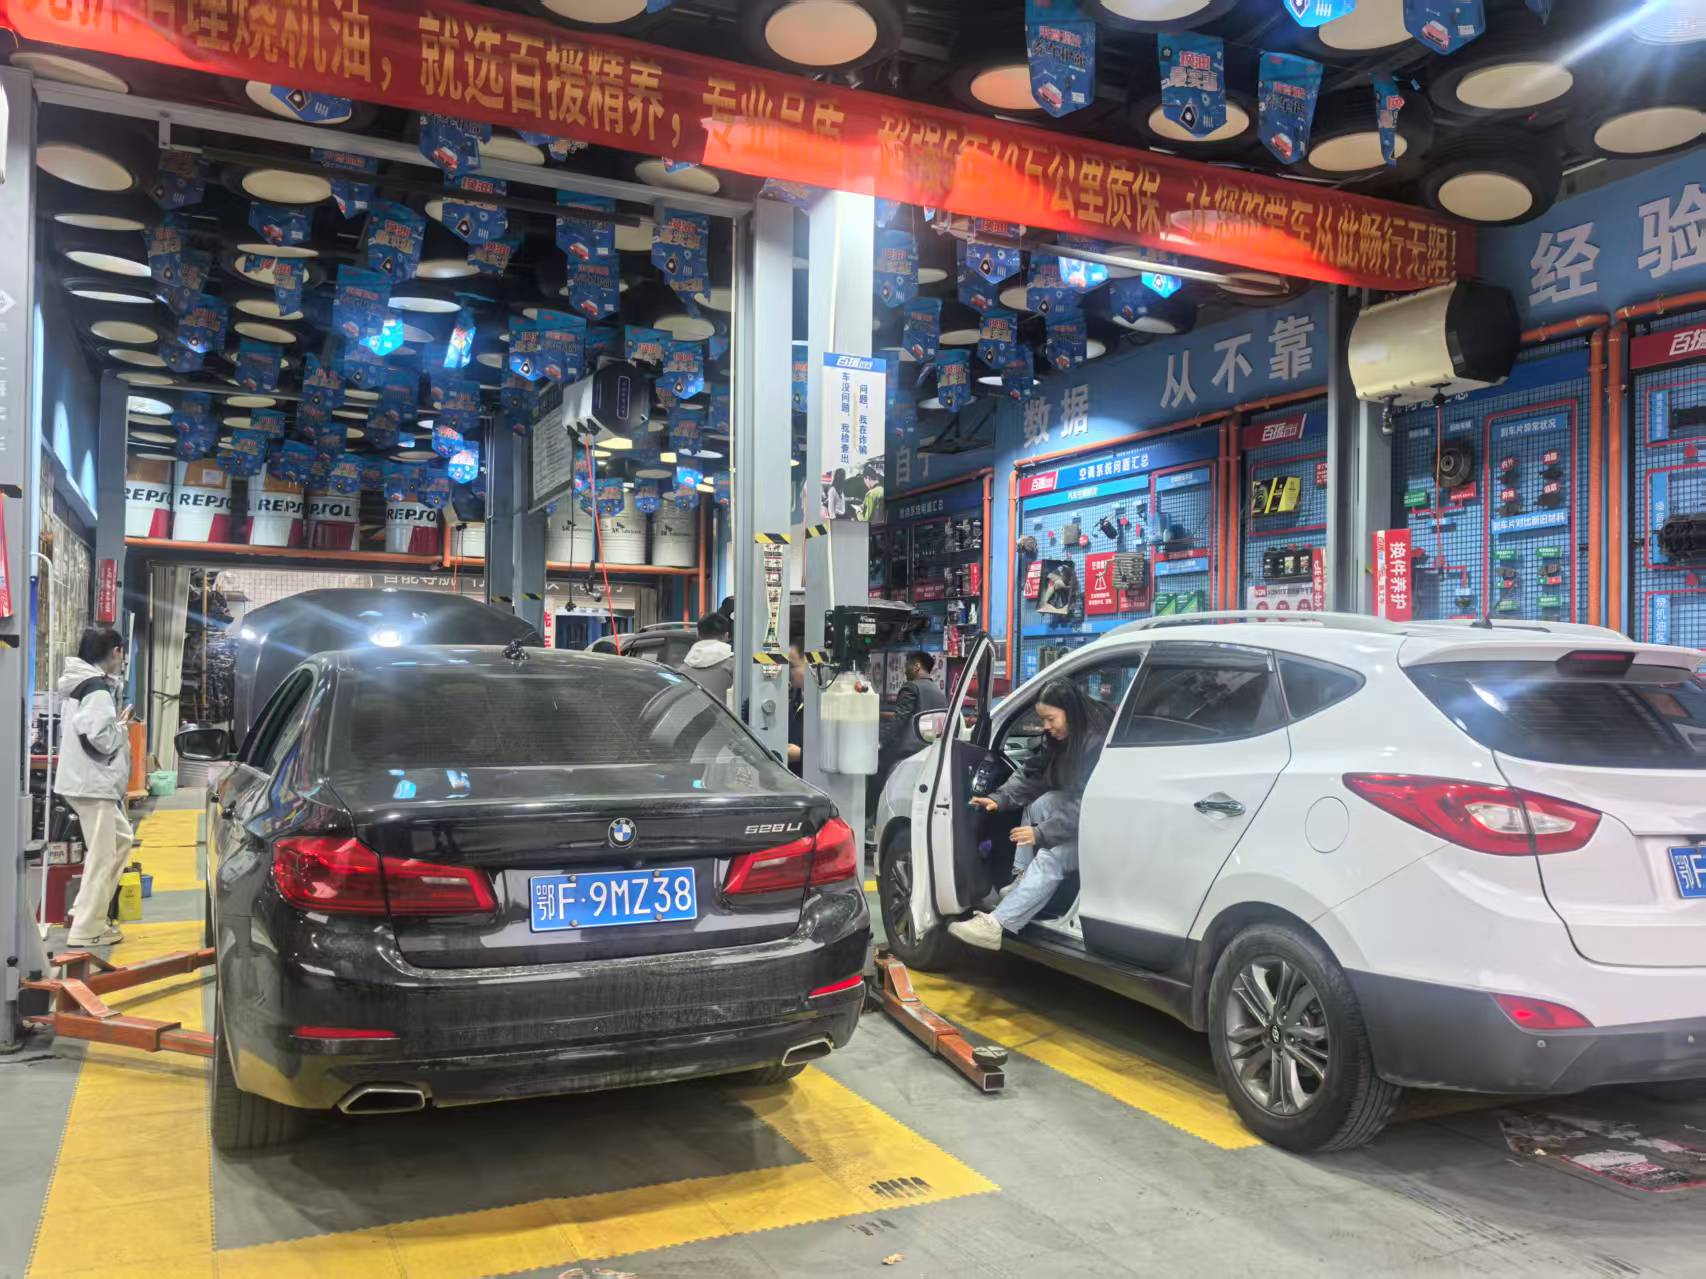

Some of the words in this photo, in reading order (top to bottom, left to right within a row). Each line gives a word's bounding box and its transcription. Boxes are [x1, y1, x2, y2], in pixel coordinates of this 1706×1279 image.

[1024, 384, 1088, 448] 数据
[1159, 315, 1314, 408] 从不靠
[1528, 183, 1706, 306] 经验
